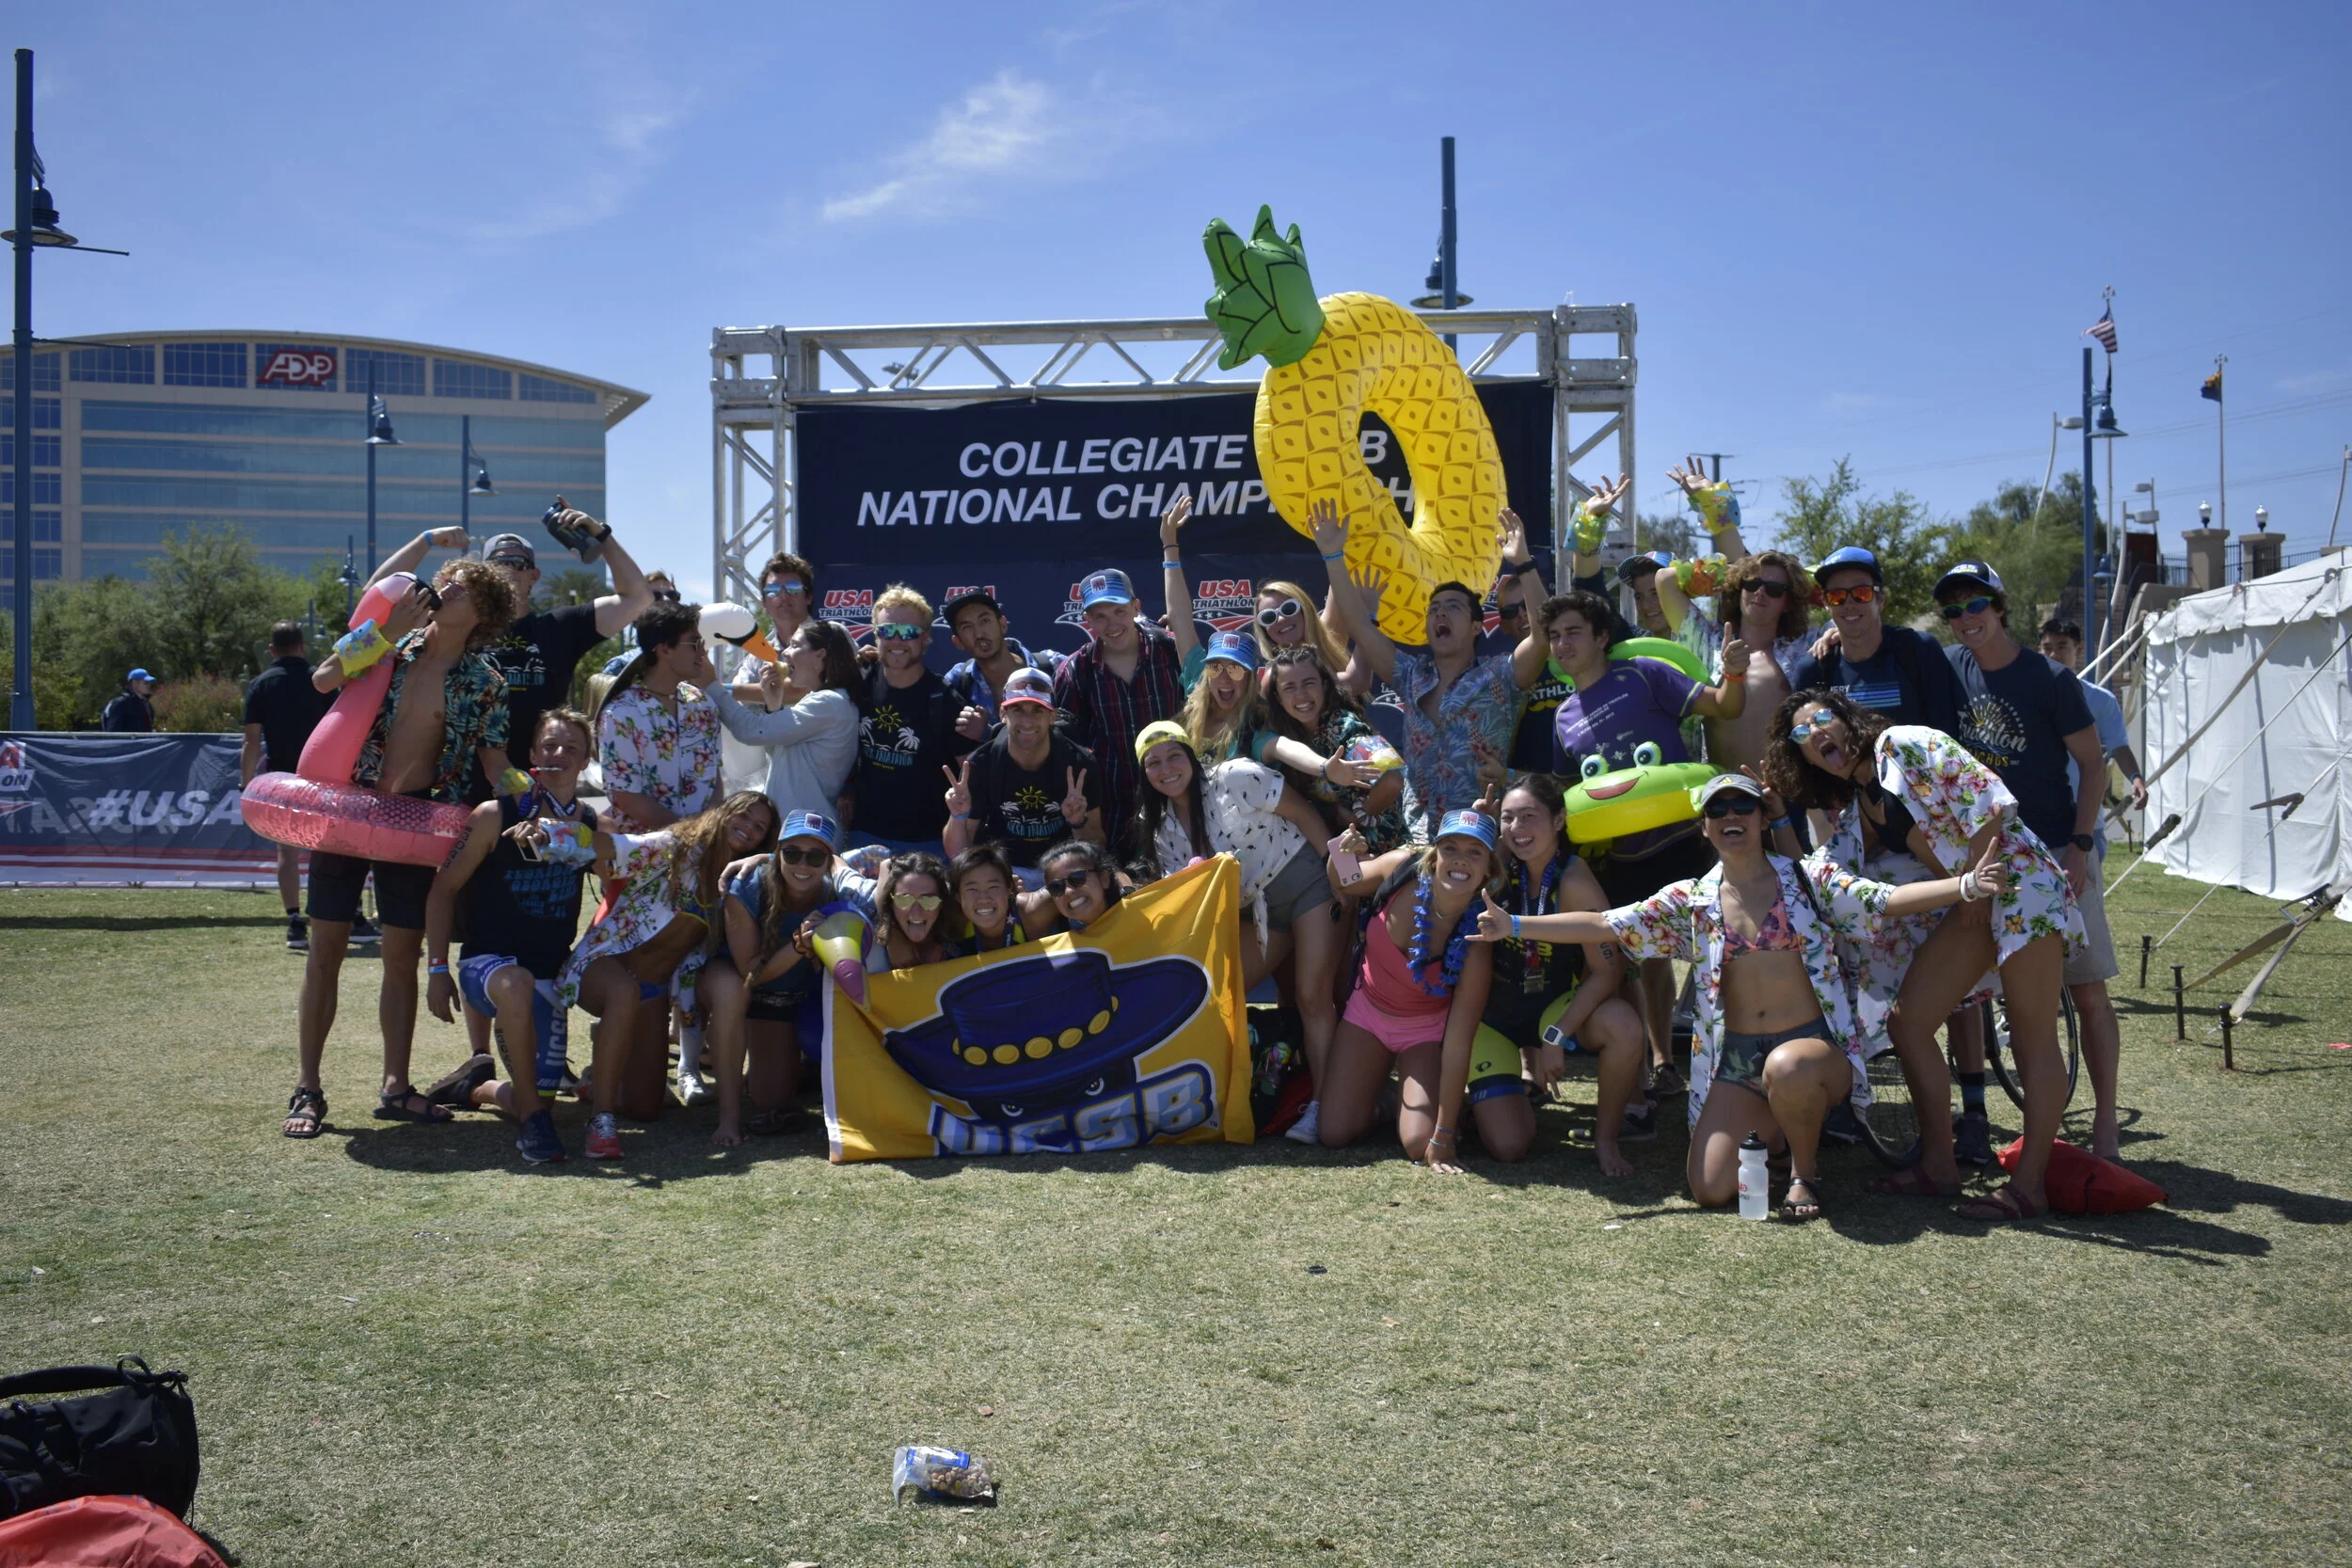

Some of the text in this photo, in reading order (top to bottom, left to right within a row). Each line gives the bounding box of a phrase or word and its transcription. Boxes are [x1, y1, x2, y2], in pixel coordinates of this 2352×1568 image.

[262, 352, 335, 383] ADP
[959, 435, 1248, 478] COLLEGIATE
[857, 486, 1082, 527] NATIONAL
[824, 589, 873, 608] USA
[945, 586, 994, 602] UA
[1199, 579, 1251, 599] USA
[1193, 596, 1256, 610] TRIATHLON
[818, 607, 874, 619] TRIATHLO
